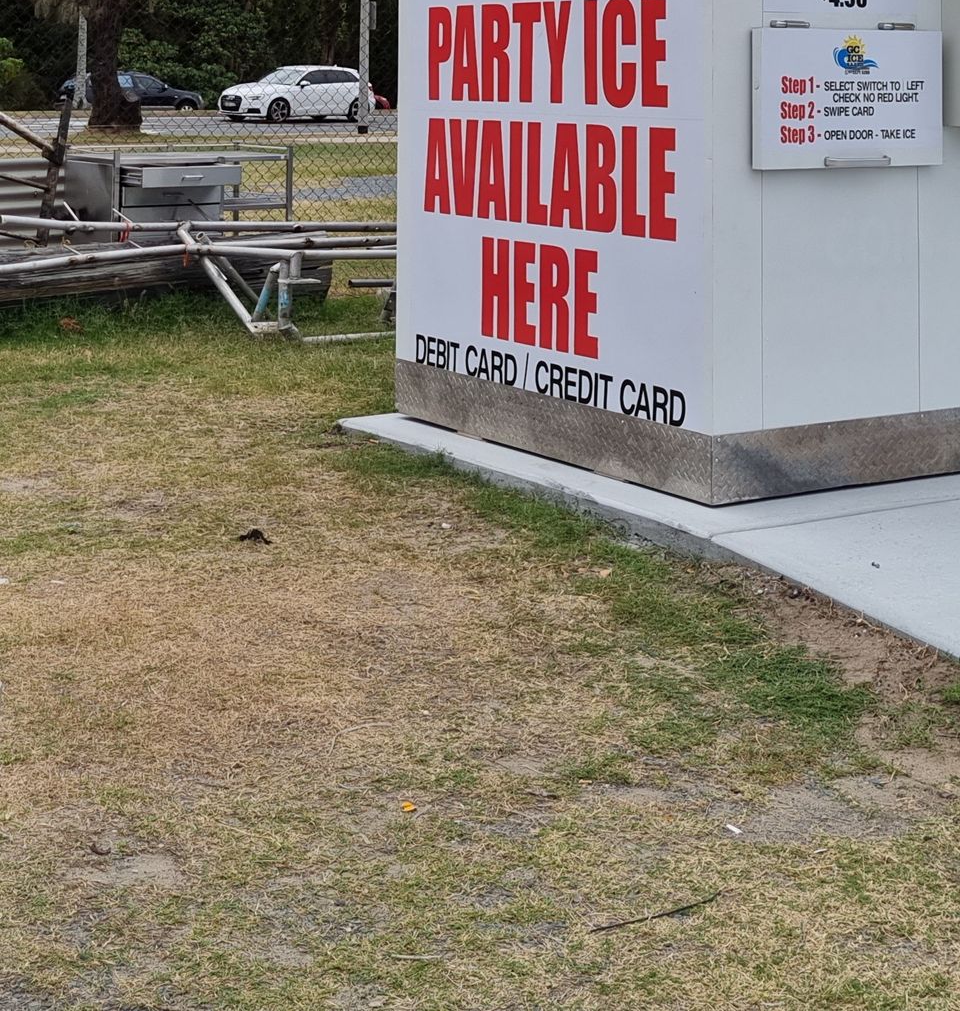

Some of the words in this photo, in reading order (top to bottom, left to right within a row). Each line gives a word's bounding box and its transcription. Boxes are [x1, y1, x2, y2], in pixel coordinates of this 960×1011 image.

[427, 0, 572, 105] PARTY
[847, 46, 860, 54] GC
[781, 75, 806, 95] Step
[824, 80, 855, 92] SELECT
[856, 80, 887, 91] SWITCH
[889, 80, 901, 91] TO
[906, 80, 924, 91] LEFT
[832, 92, 861, 103] CHECK
[863, 92, 876, 103] NO
[877, 92, 894, 103] RED
[780, 101, 805, 121] Step
[823, 106, 850, 117] SWIPE
[851, 106, 875, 116] CARD
[780, 125, 805, 145] Step
[824, 130, 847, 140] OPEN
[849, 129, 873, 140] DOOR
[880, 129, 901, 139] TAKE
[903, 129, 916, 139] ICE
[423, 117, 677, 242] AVAILABLE
[480, 235, 599, 360] HERE
[415, 334, 460, 373] DEBIT
[465, 345, 517, 386] CARD
[535, 360, 613, 410] CREDIT
[619, 378, 686, 427] CARD
